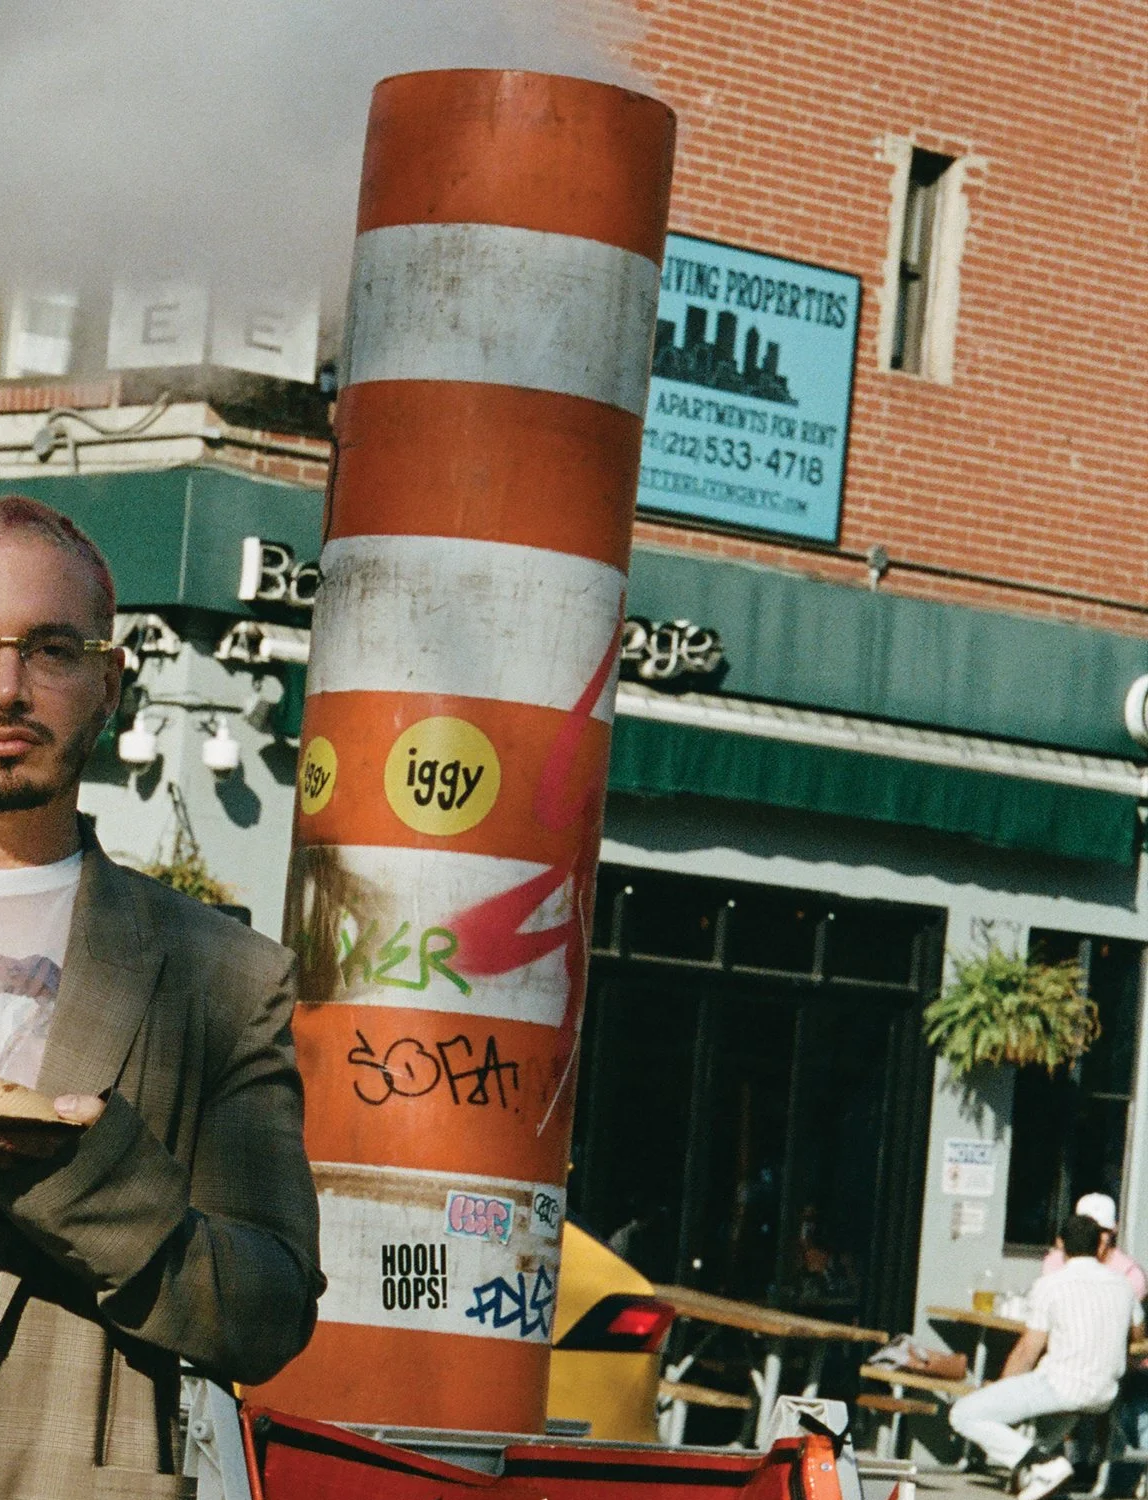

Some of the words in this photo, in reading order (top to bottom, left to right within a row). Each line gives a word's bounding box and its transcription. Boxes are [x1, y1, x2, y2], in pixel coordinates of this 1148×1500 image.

[724, 268, 848, 329] PROPERTIES
[704, 436, 824, 486] 533-4718
[304, 752, 331, 798] iggy
[407, 747, 484, 810] iggy
[382, 1243, 447, 1276] HOOLI
[382, 1277, 448, 1311] OOPS!
